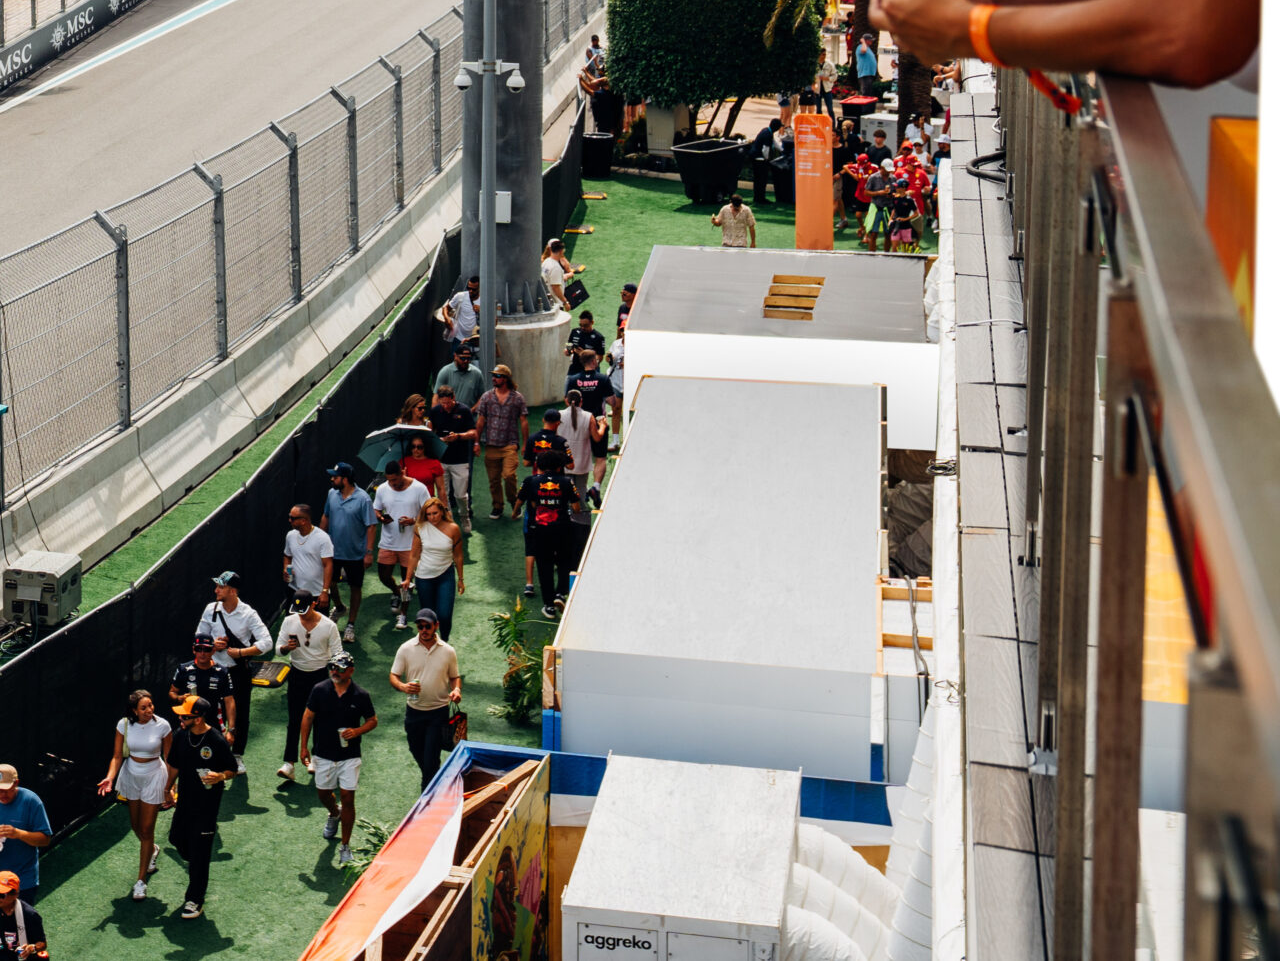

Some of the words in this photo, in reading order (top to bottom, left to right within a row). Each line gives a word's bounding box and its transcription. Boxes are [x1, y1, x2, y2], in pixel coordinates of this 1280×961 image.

[67, 6, 94, 38] MSC
[67, 25, 95, 46] CRUISES
[584, 934, 652, 951] aggreko
